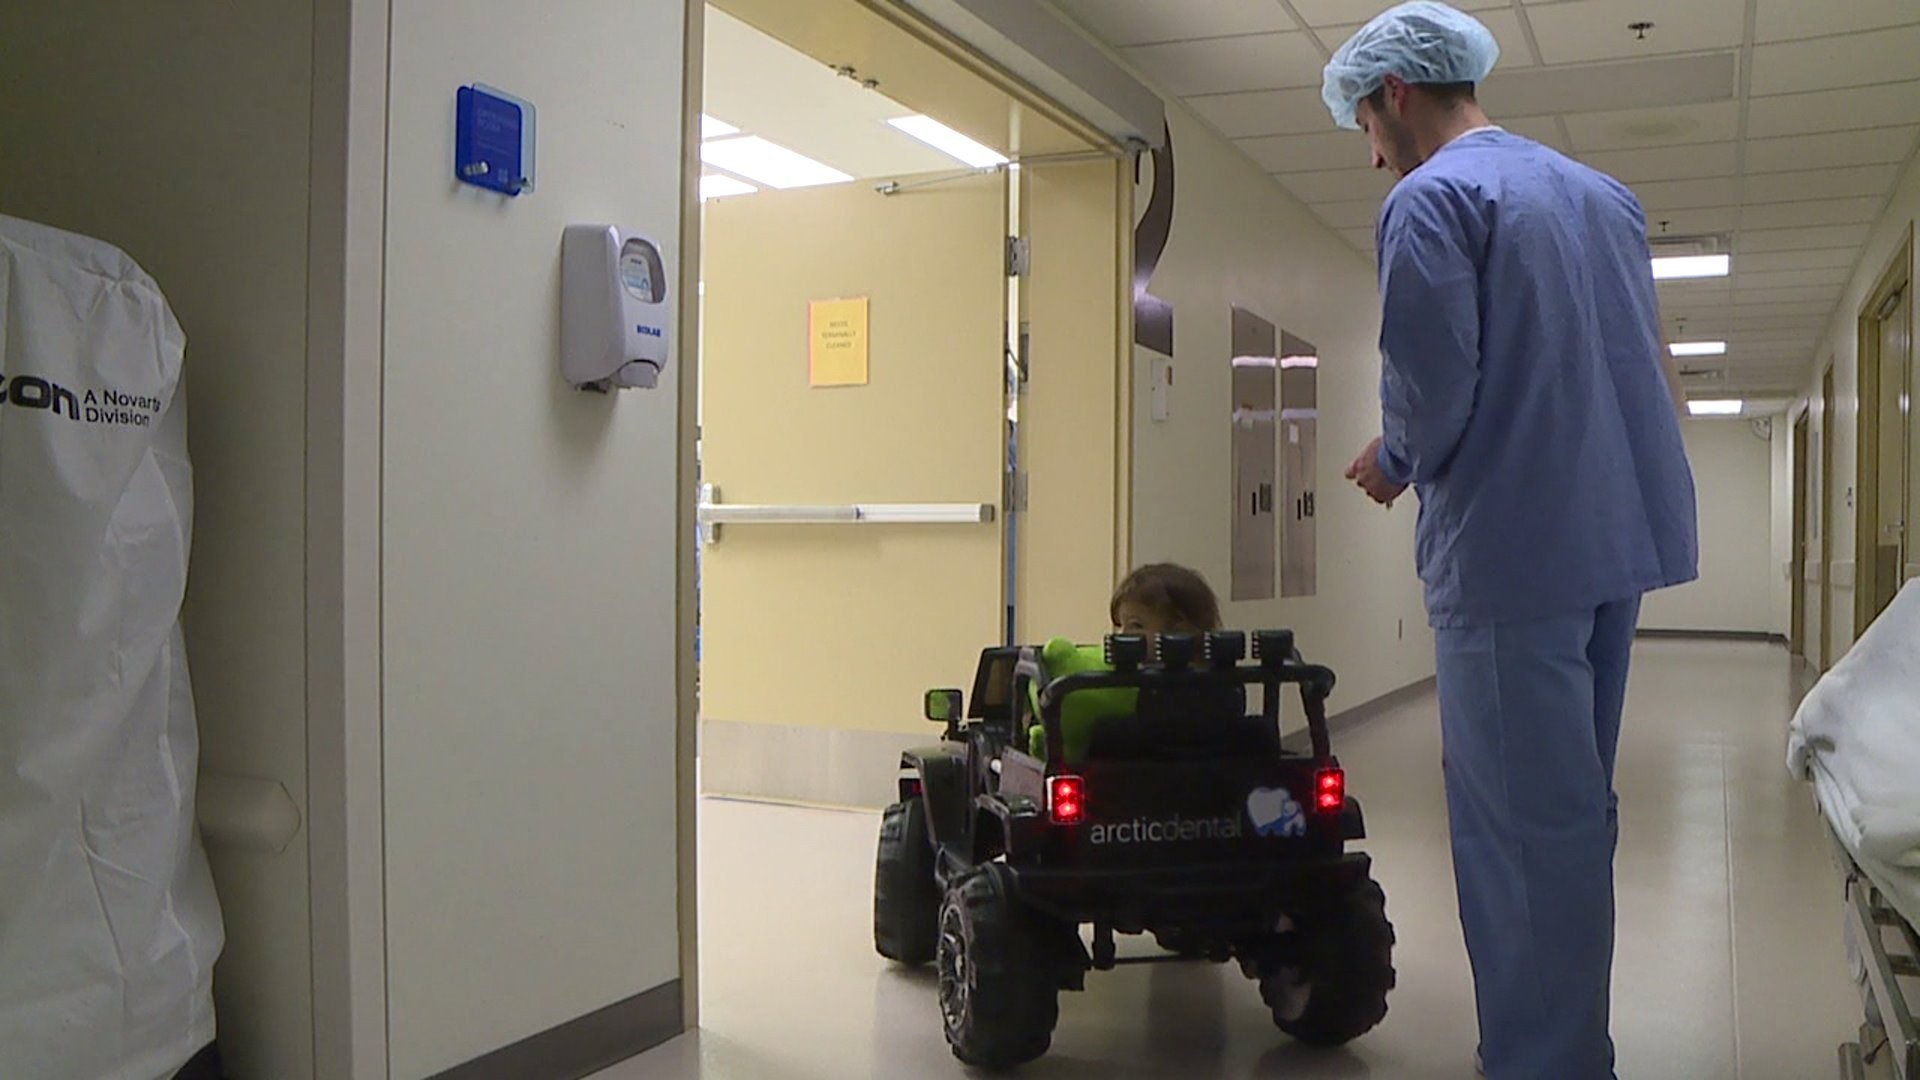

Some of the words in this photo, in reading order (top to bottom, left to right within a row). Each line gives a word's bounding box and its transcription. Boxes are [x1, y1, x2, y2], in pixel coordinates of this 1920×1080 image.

[636, 325, 661, 337] ECOLAB
[0, 373, 80, 420] on
[84, 389, 97, 405] A
[86, 407, 151, 427] Division
